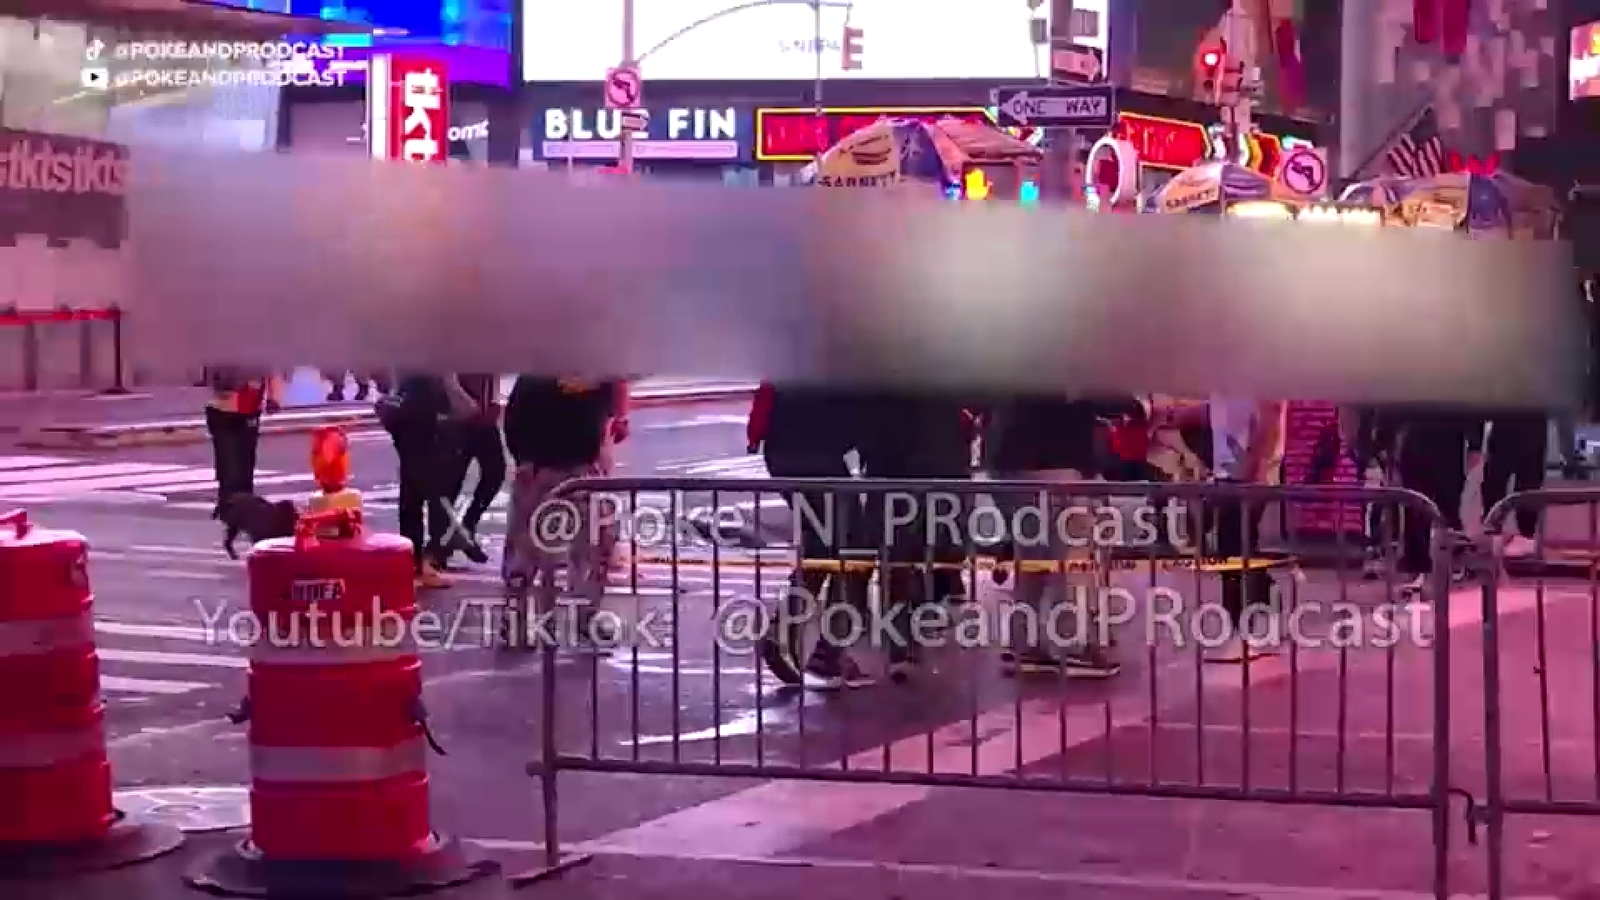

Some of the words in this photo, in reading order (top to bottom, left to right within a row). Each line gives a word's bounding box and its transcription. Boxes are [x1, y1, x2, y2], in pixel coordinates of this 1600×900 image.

[1012, 99, 1046, 115] ONE
[1066, 98, 1102, 115] WAY
[668, 108, 735, 139] FIN
